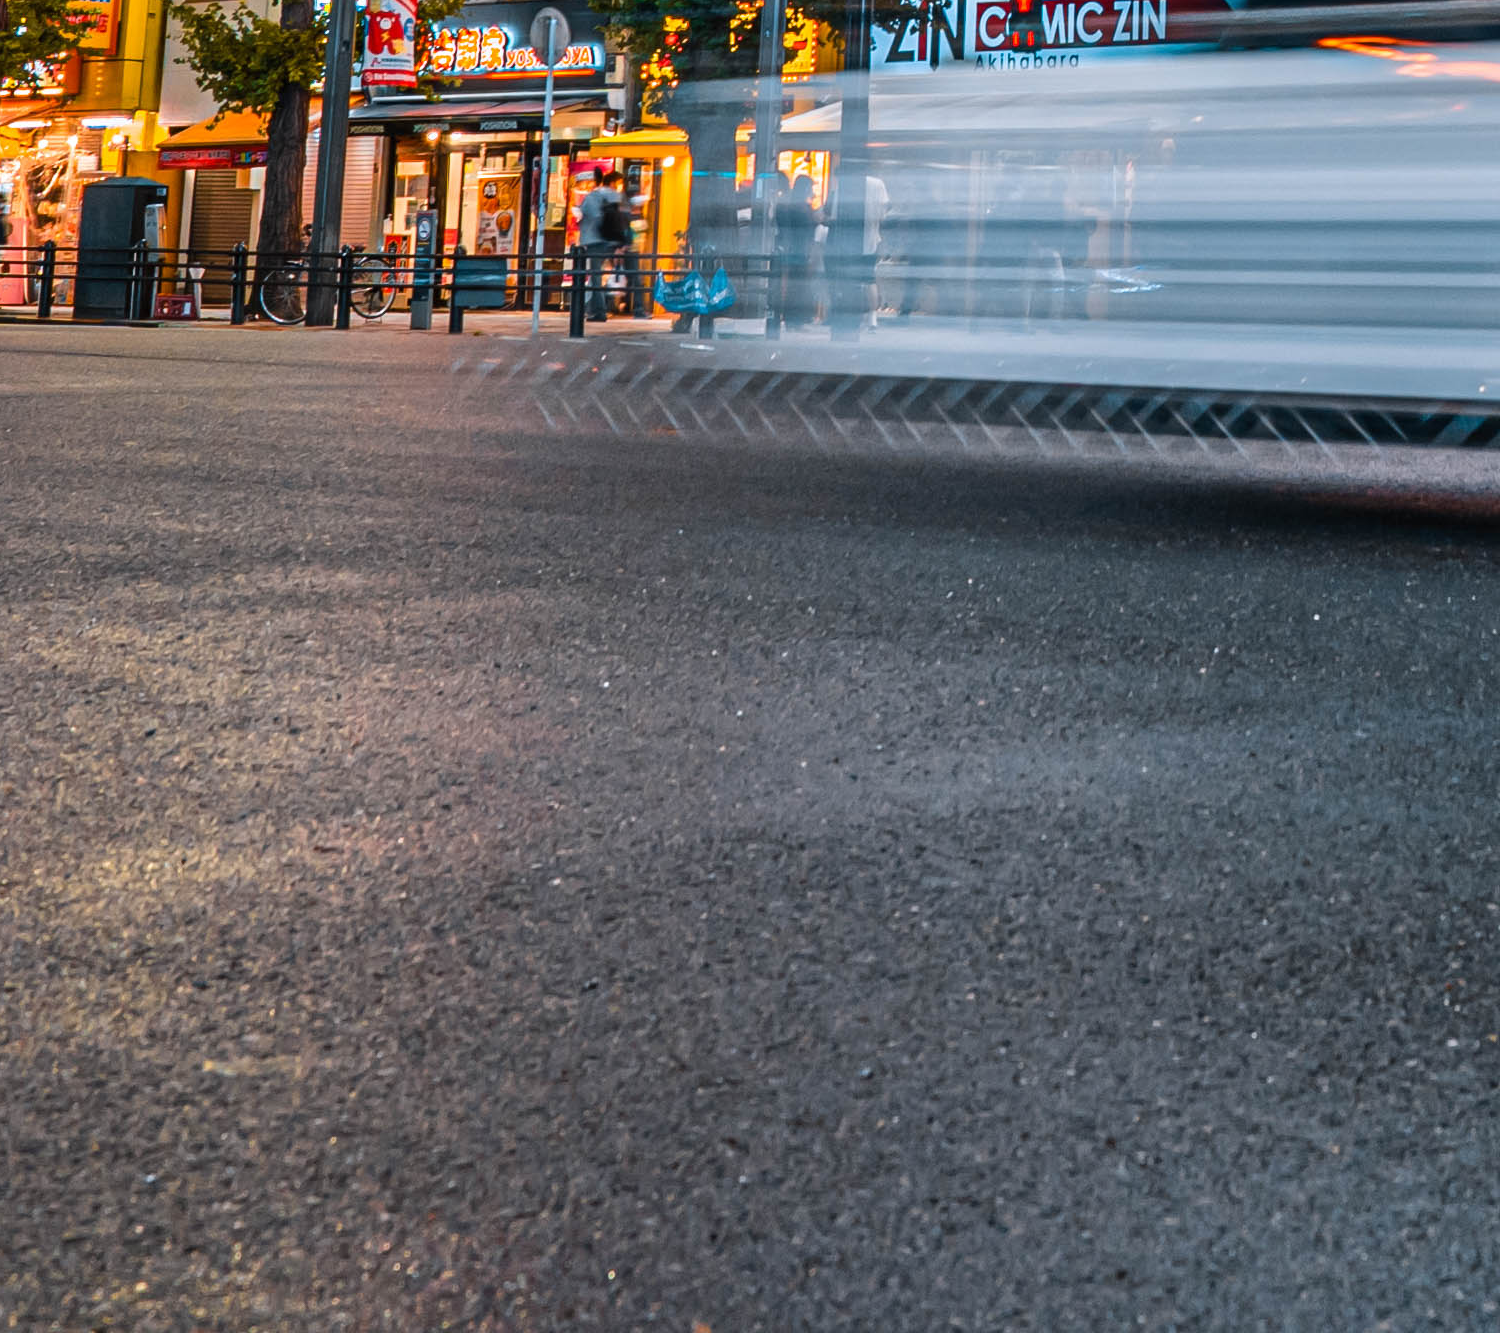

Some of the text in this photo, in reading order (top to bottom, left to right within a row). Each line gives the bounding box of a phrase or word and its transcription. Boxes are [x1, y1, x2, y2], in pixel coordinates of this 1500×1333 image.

[978, 0, 1103, 49] CMIC
[431, 25, 506, 72] 吉野家
[974, 52, 1081, 73] Akihabara
